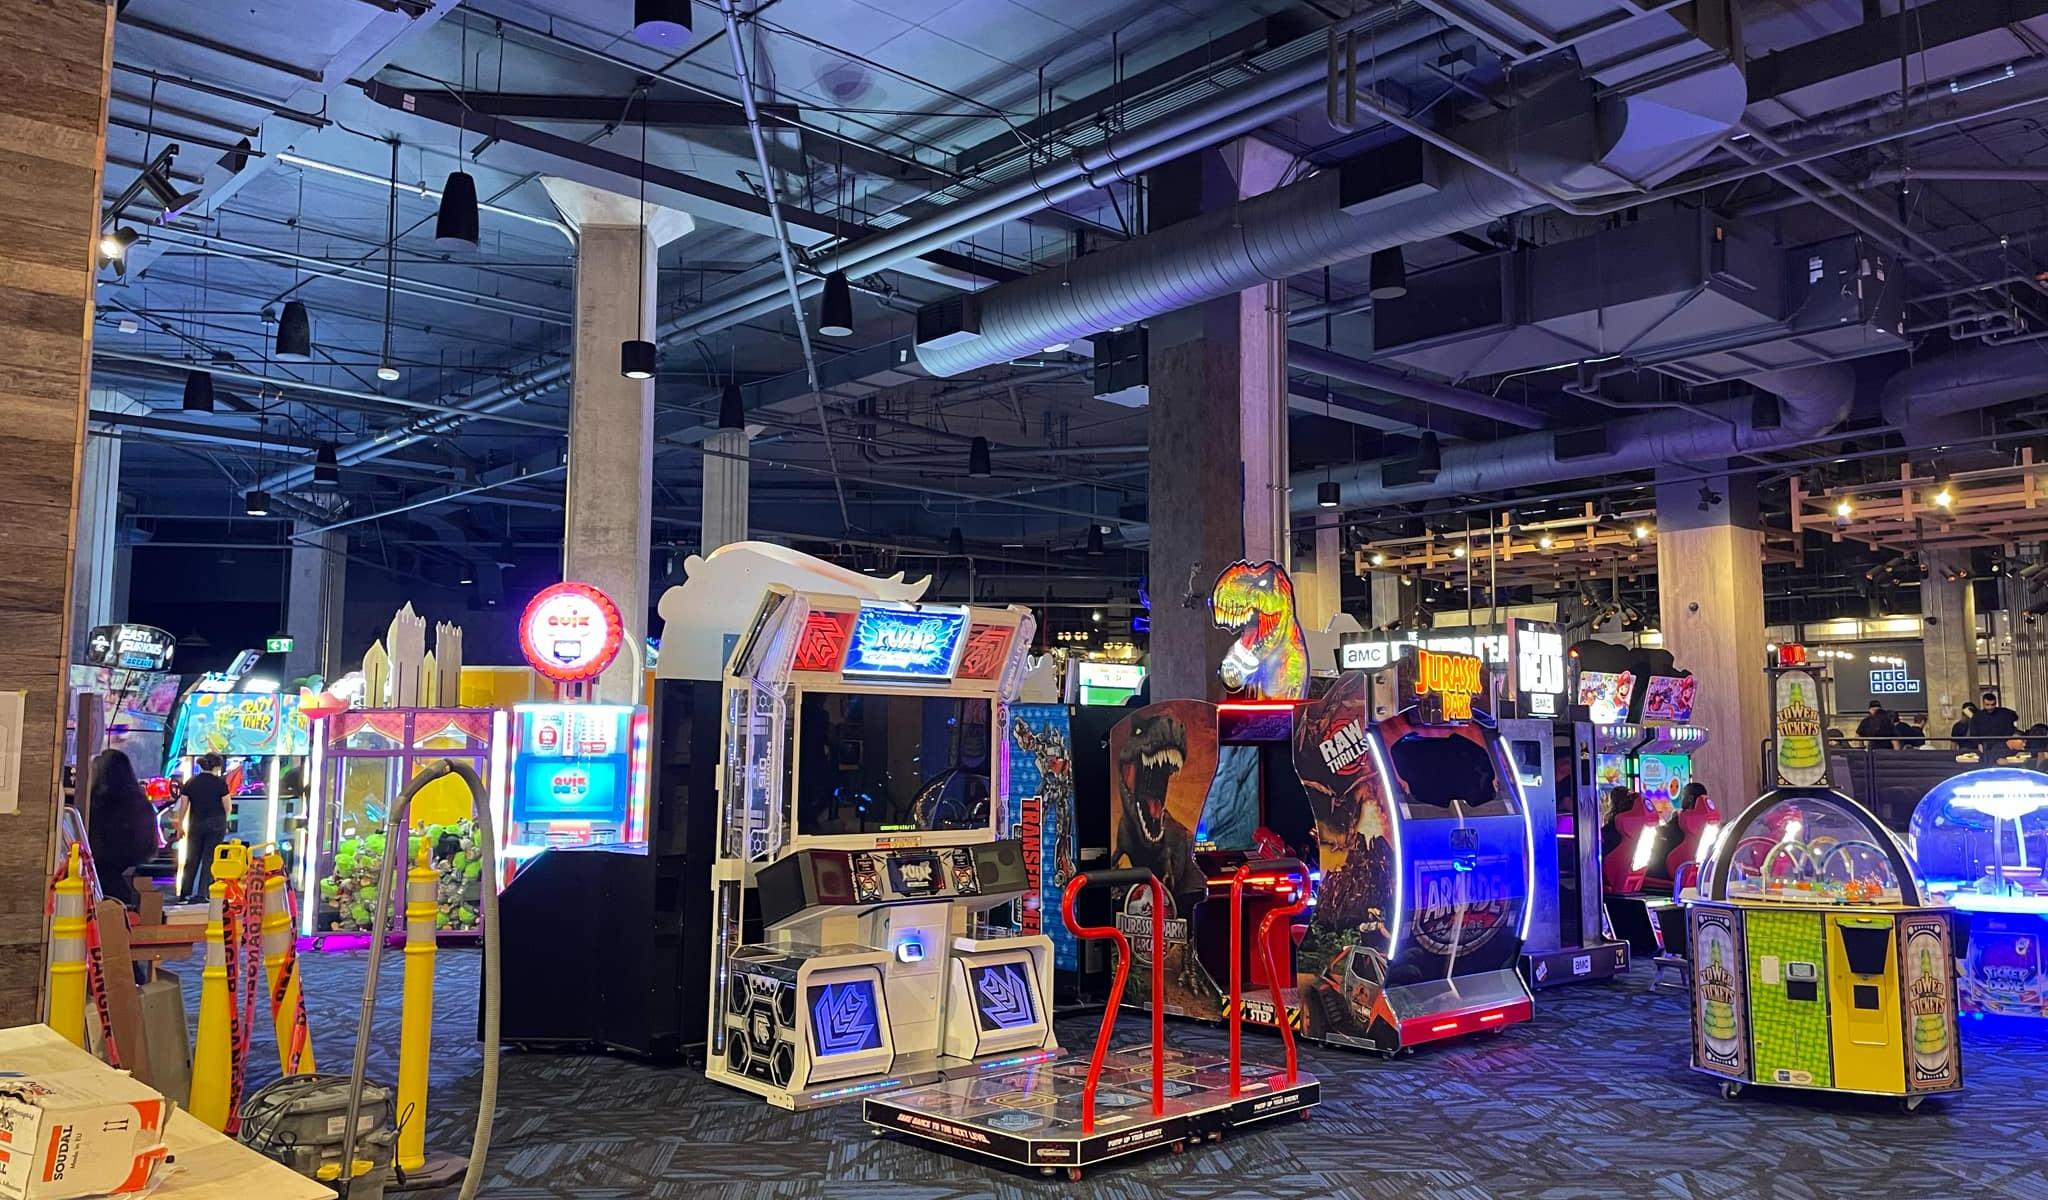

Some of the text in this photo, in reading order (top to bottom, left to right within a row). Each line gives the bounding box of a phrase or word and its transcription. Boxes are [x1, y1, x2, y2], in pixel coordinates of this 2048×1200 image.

[1415, 650, 1483, 695] JURASSIC
[1873, 672, 1904, 681] REC
[1873, 682, 1917, 691] ROOM
[1443, 690, 1472, 721] PARK
[1777, 700, 1819, 722] TOWER
[1319, 718, 1363, 763] RAW
[1777, 720, 1821, 737] TICKETS
[1327, 737, 1370, 774] THRILLS
[1022, 799, 1040, 936] TRANSFORMER
[1120, 916, 1153, 935] JURASSI
[1700, 960, 1733, 986] TOWER
[1910, 971, 1944, 997] TOWER
[1700, 984, 1735, 1005] TICKETS
[1910, 996, 1945, 1016] TICKETS
[1250, 1009, 1272, 1023] STEP
[54, 1124, 73, 1180] SOUDAL
